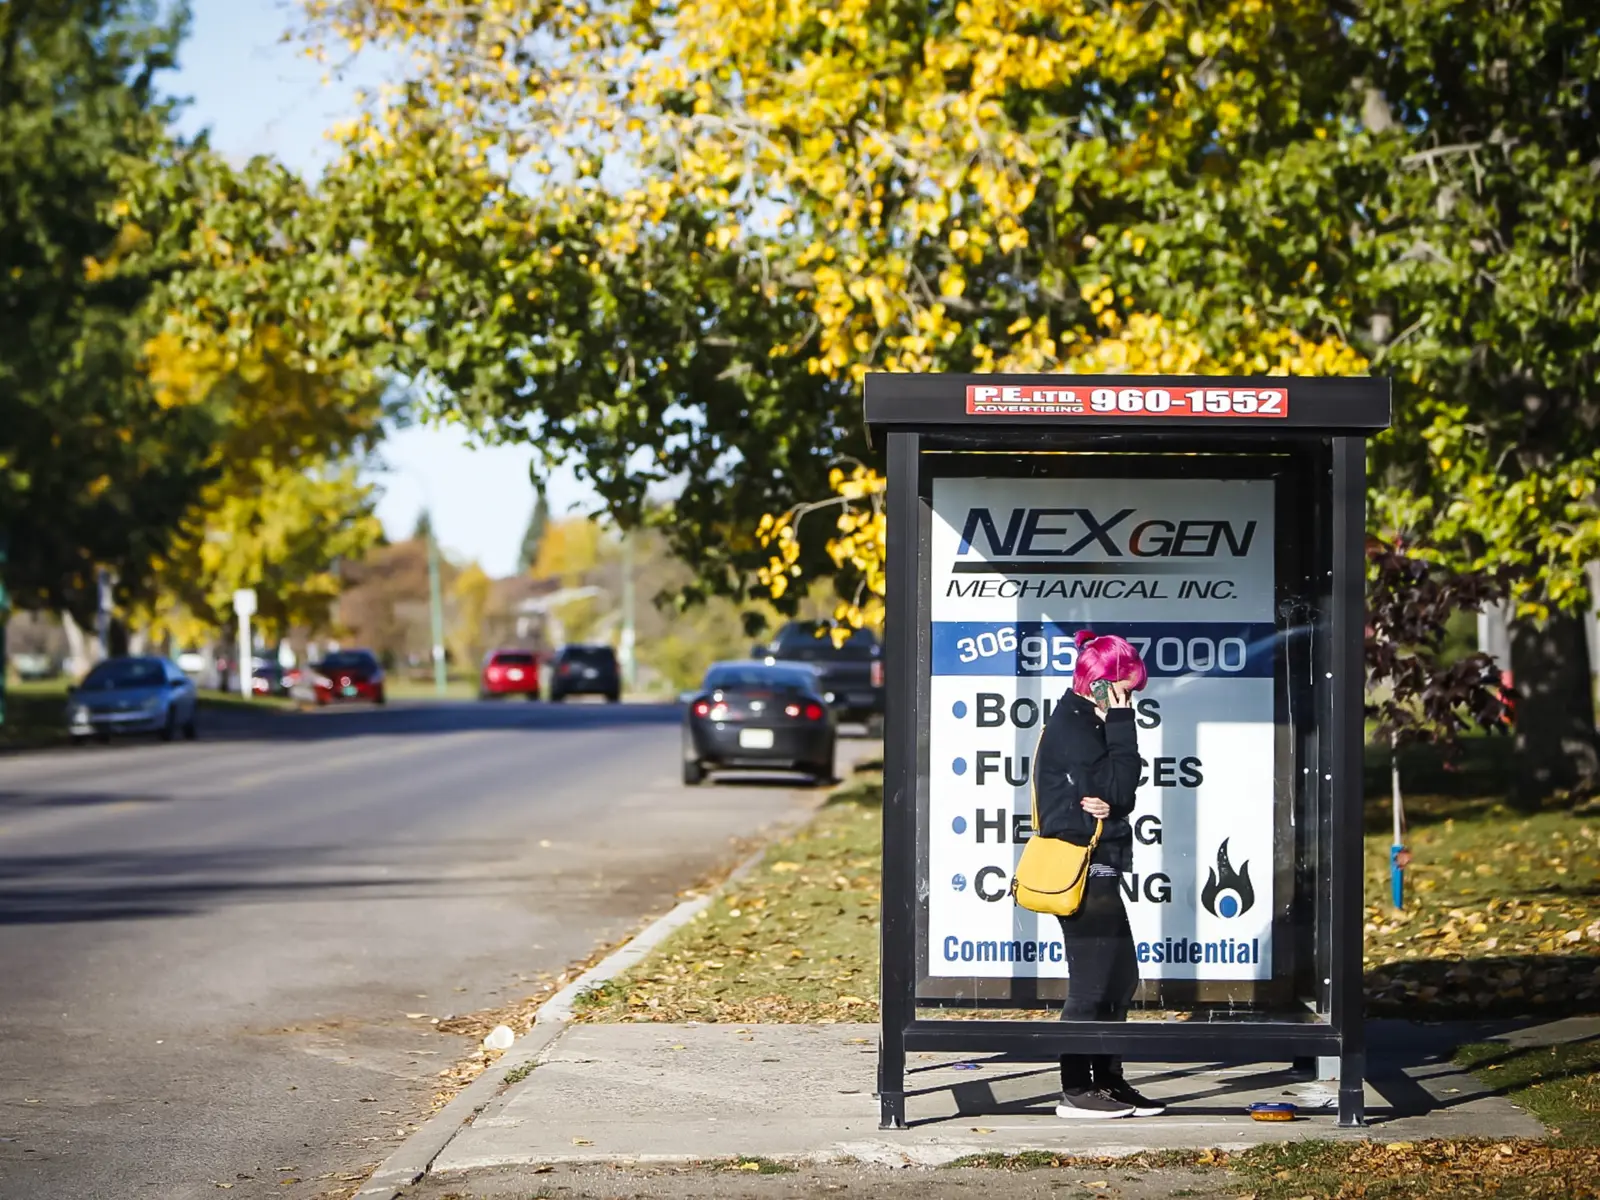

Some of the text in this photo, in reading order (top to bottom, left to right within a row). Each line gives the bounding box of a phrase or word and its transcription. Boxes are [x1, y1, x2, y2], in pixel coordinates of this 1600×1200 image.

[1090, 389, 1282, 414] 960-1552
[946, 580, 1238, 599] MECHANICAL INC.
[957, 627, 1017, 663] 306
[976, 693, 1162, 730] BOIS
[976, 751, 1204, 788] FUES
[944, 935, 1259, 964] Commerc esidential
